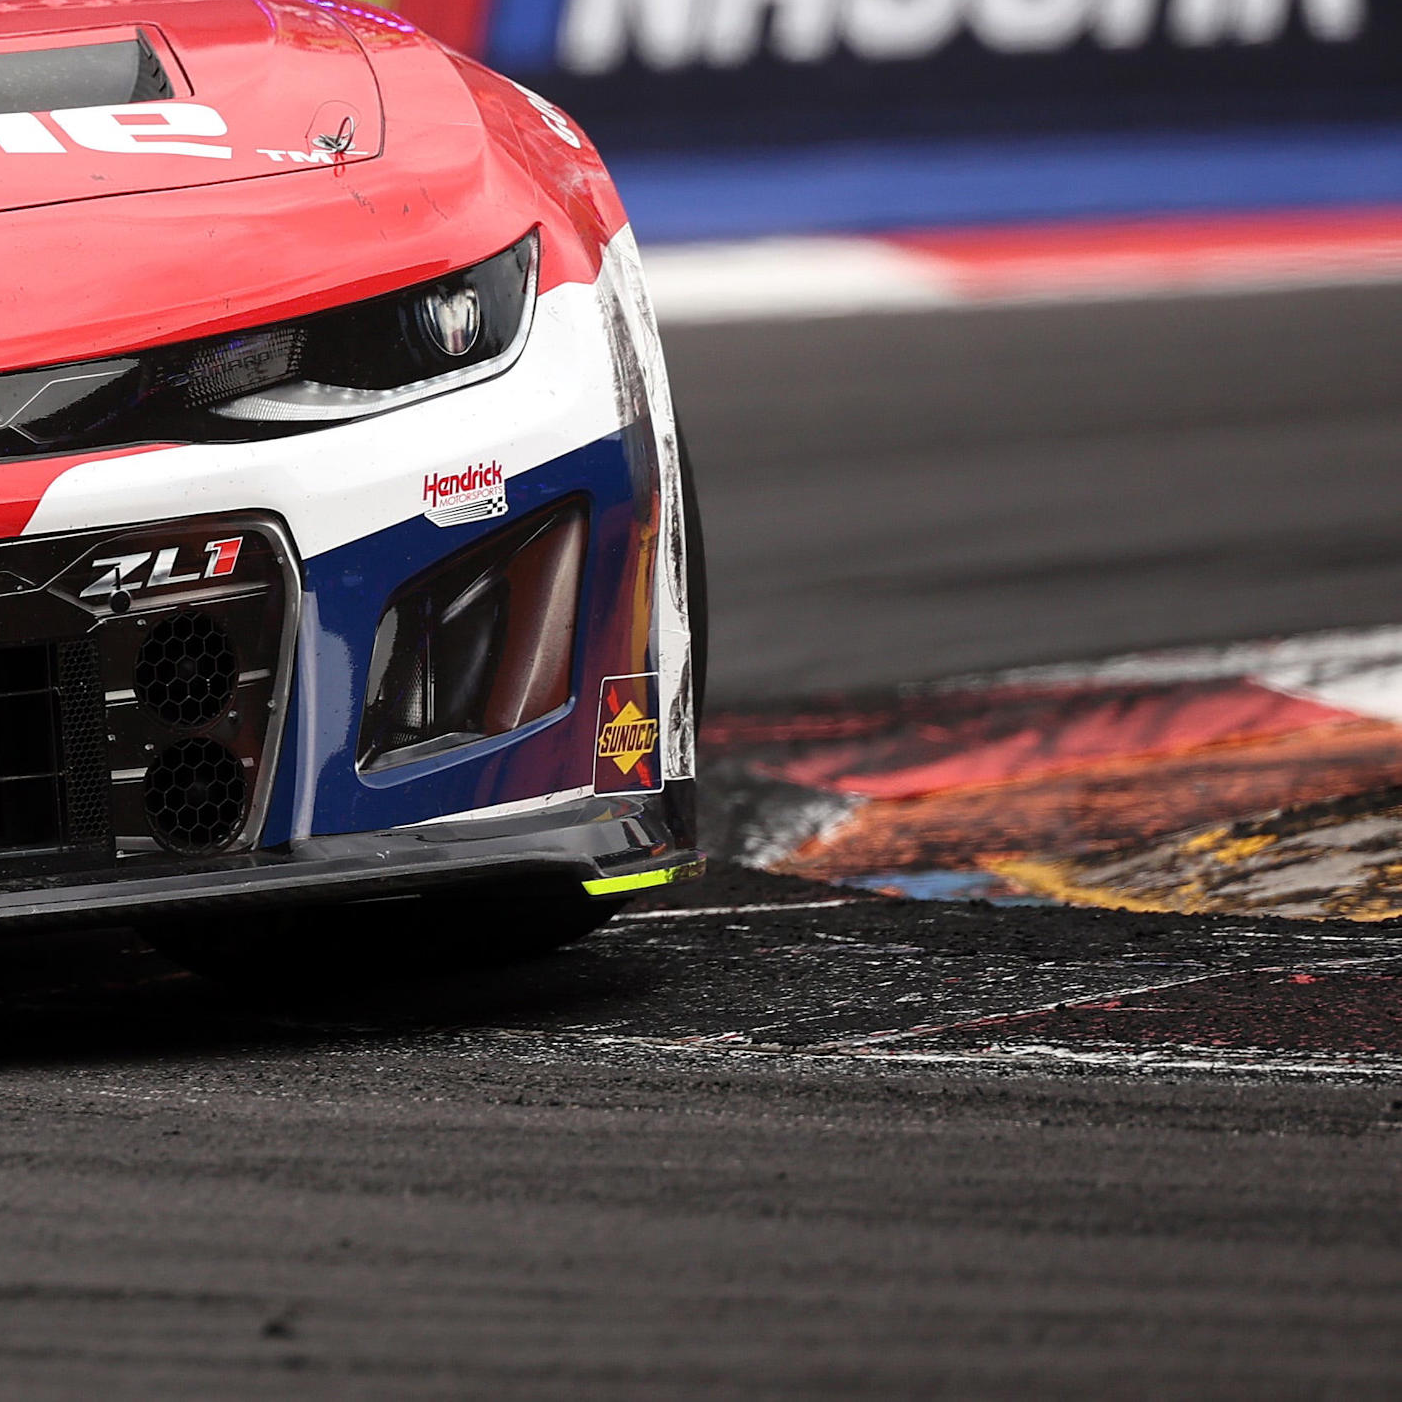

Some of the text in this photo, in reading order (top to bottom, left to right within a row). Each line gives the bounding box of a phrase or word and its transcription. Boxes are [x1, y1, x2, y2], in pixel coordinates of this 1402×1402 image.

[423, 459, 502, 508] Hendrick
[439, 485, 503, 508] MOTORSPORTS
[79, 536, 244, 598] ZL1
[600, 722, 655, 754] SUNOCO
